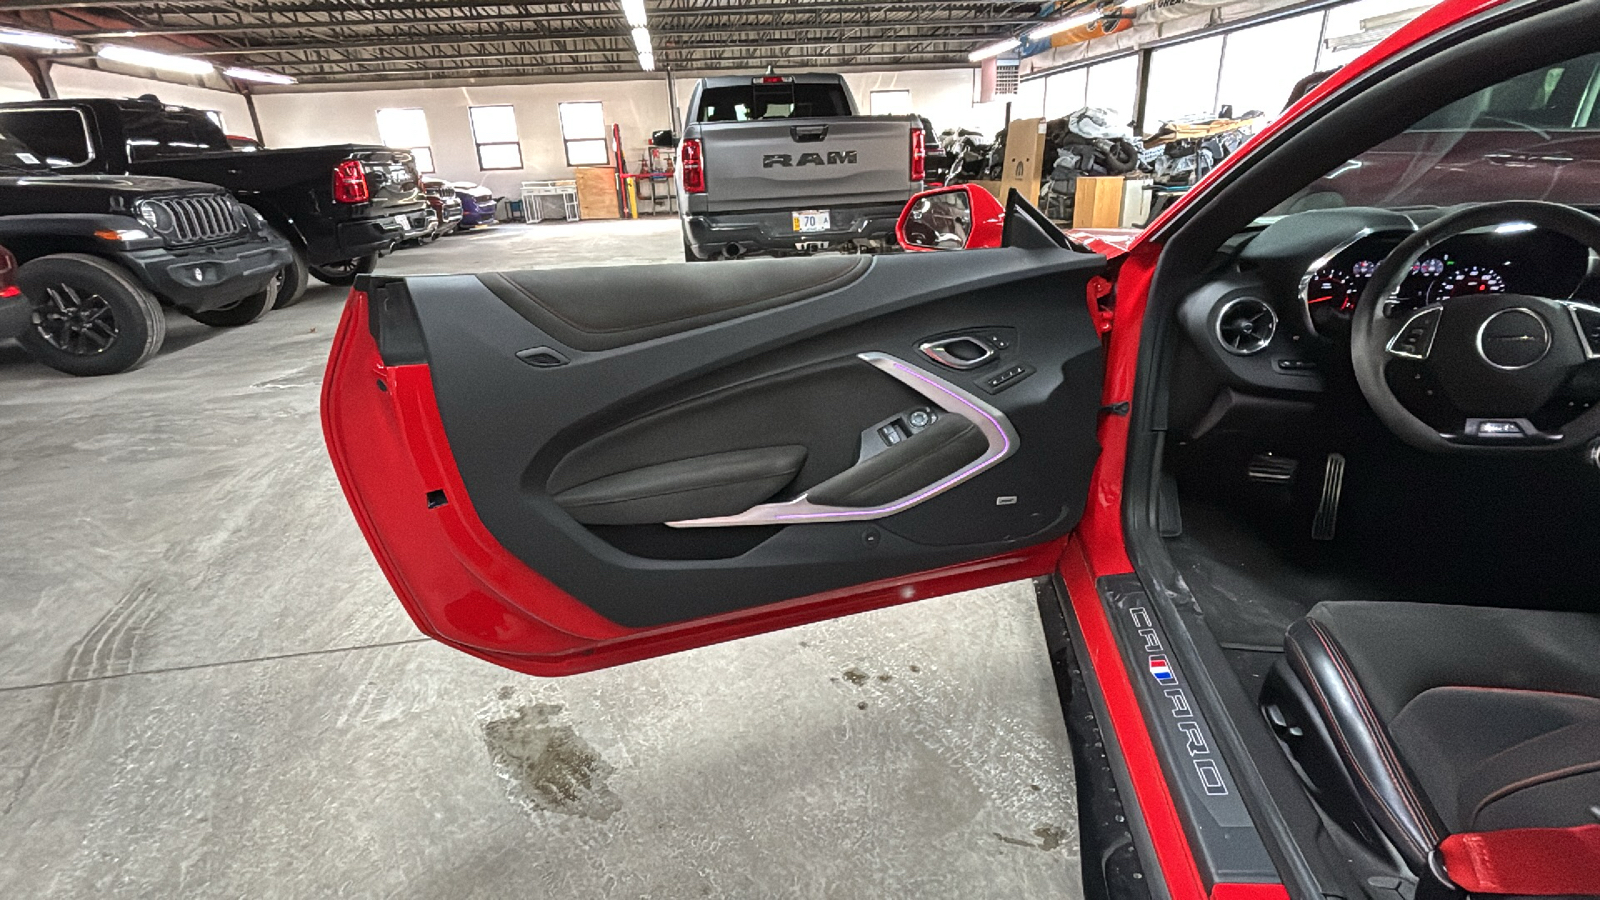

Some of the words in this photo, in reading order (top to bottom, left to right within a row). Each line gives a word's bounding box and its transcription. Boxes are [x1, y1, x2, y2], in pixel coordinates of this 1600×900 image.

[762, 150, 858, 168] RAM
[804, 216, 816, 227] 70
[1129, 606, 1229, 796] CAARO
